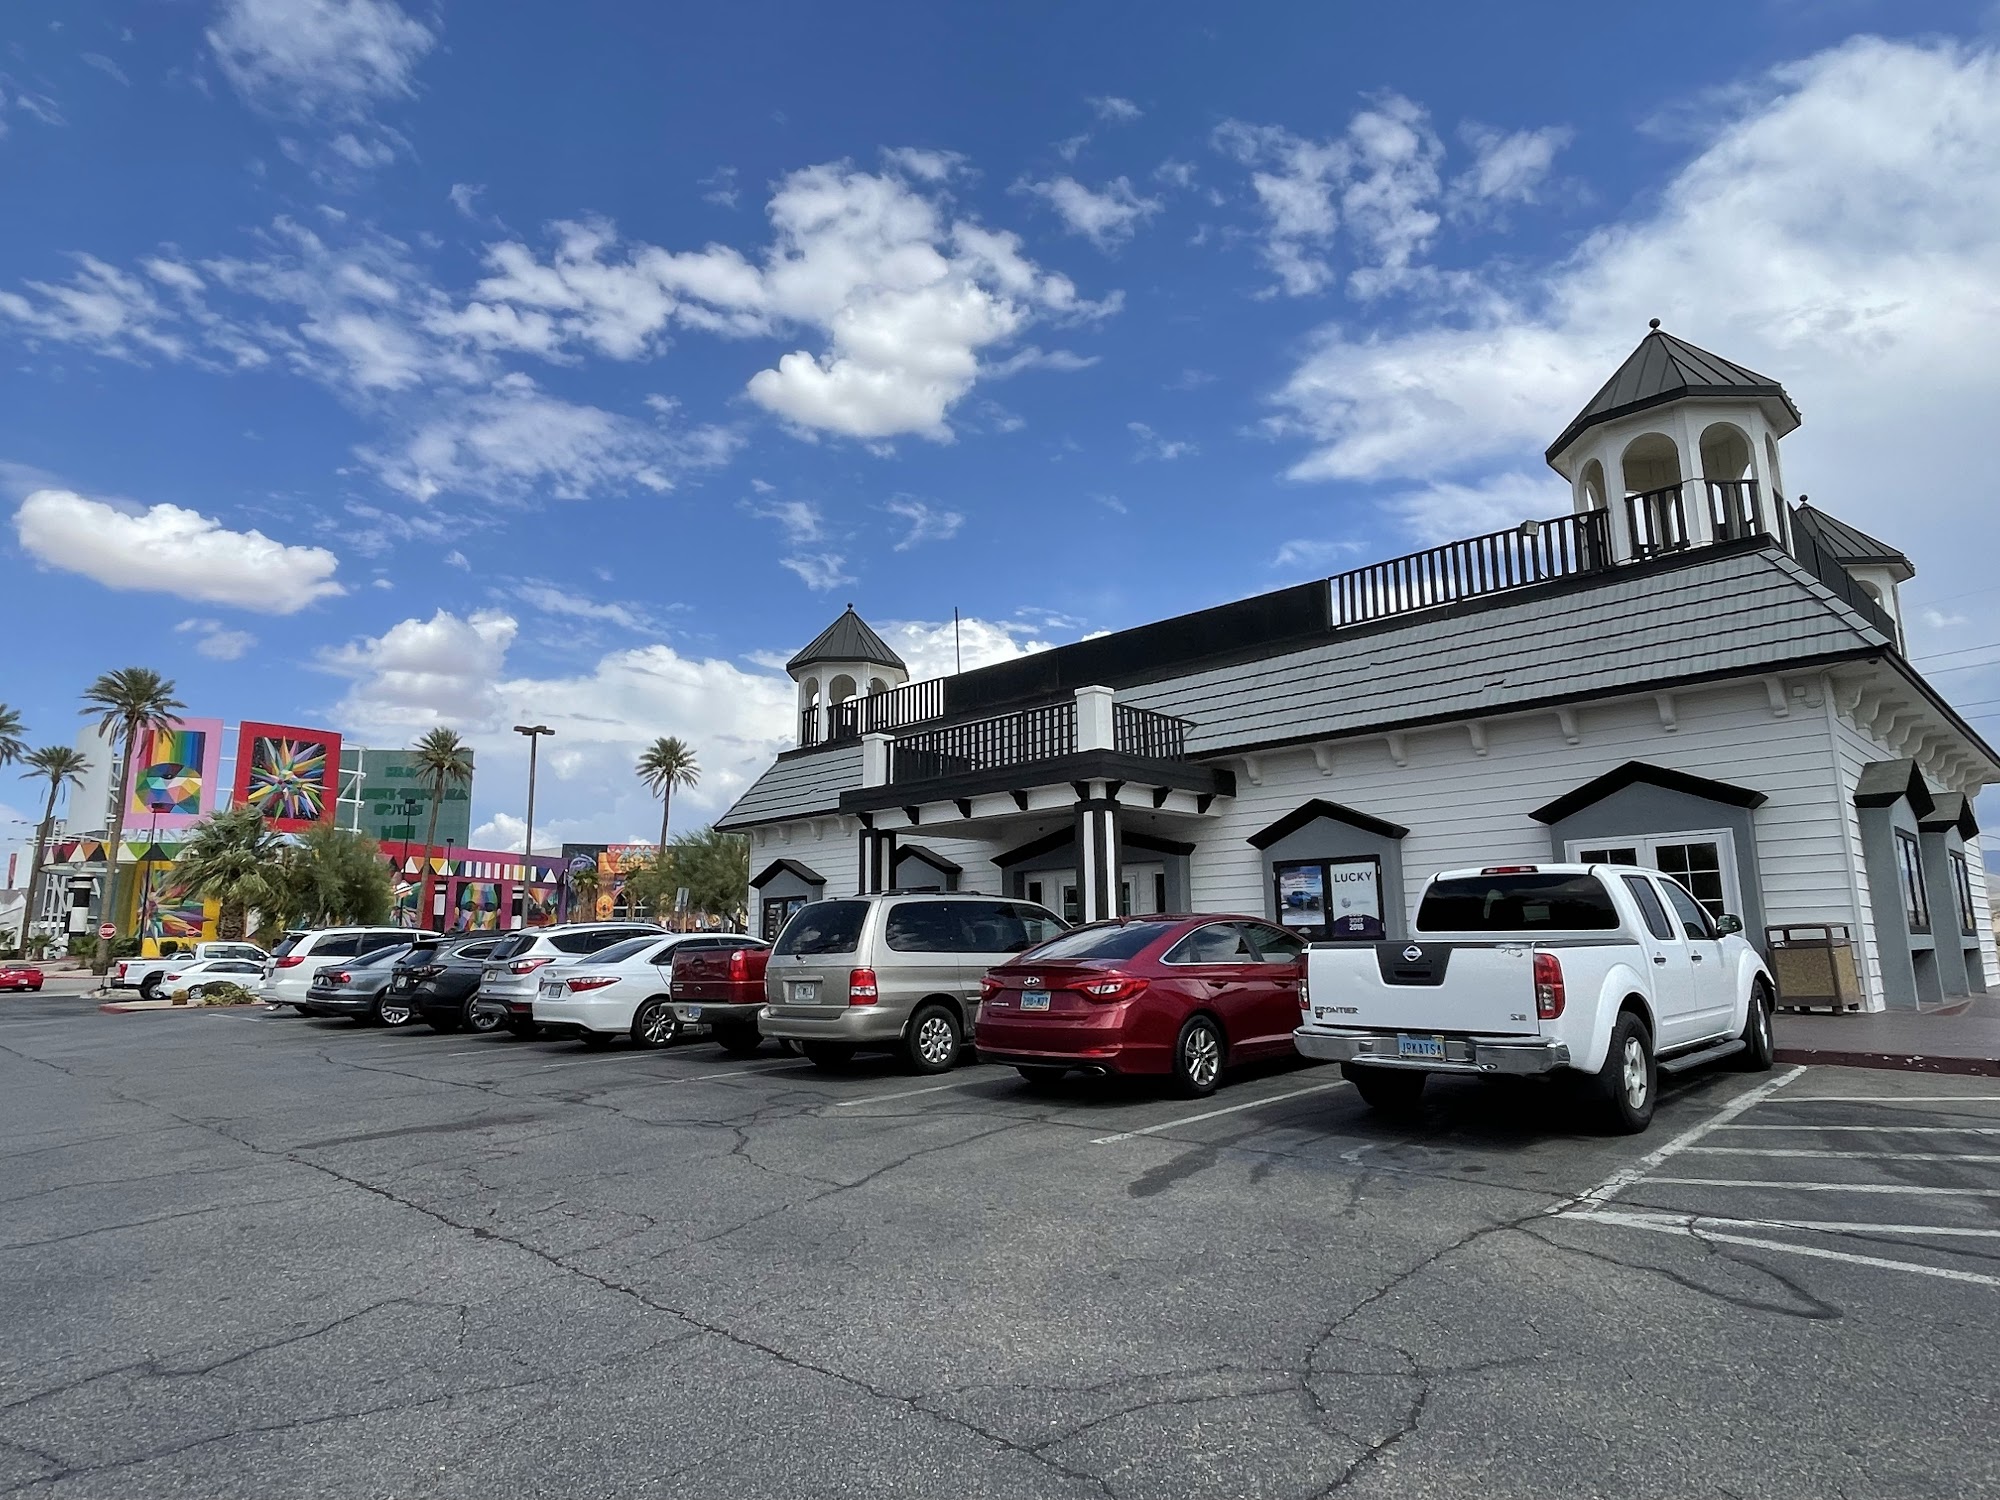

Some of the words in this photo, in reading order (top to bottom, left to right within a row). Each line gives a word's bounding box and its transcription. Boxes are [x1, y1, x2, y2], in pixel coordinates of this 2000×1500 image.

[1334, 871, 1372, 883] LUCKY
[1314, 1006, 1360, 1015] FRONTIER
[1510, 1013, 1527, 1021] SE
